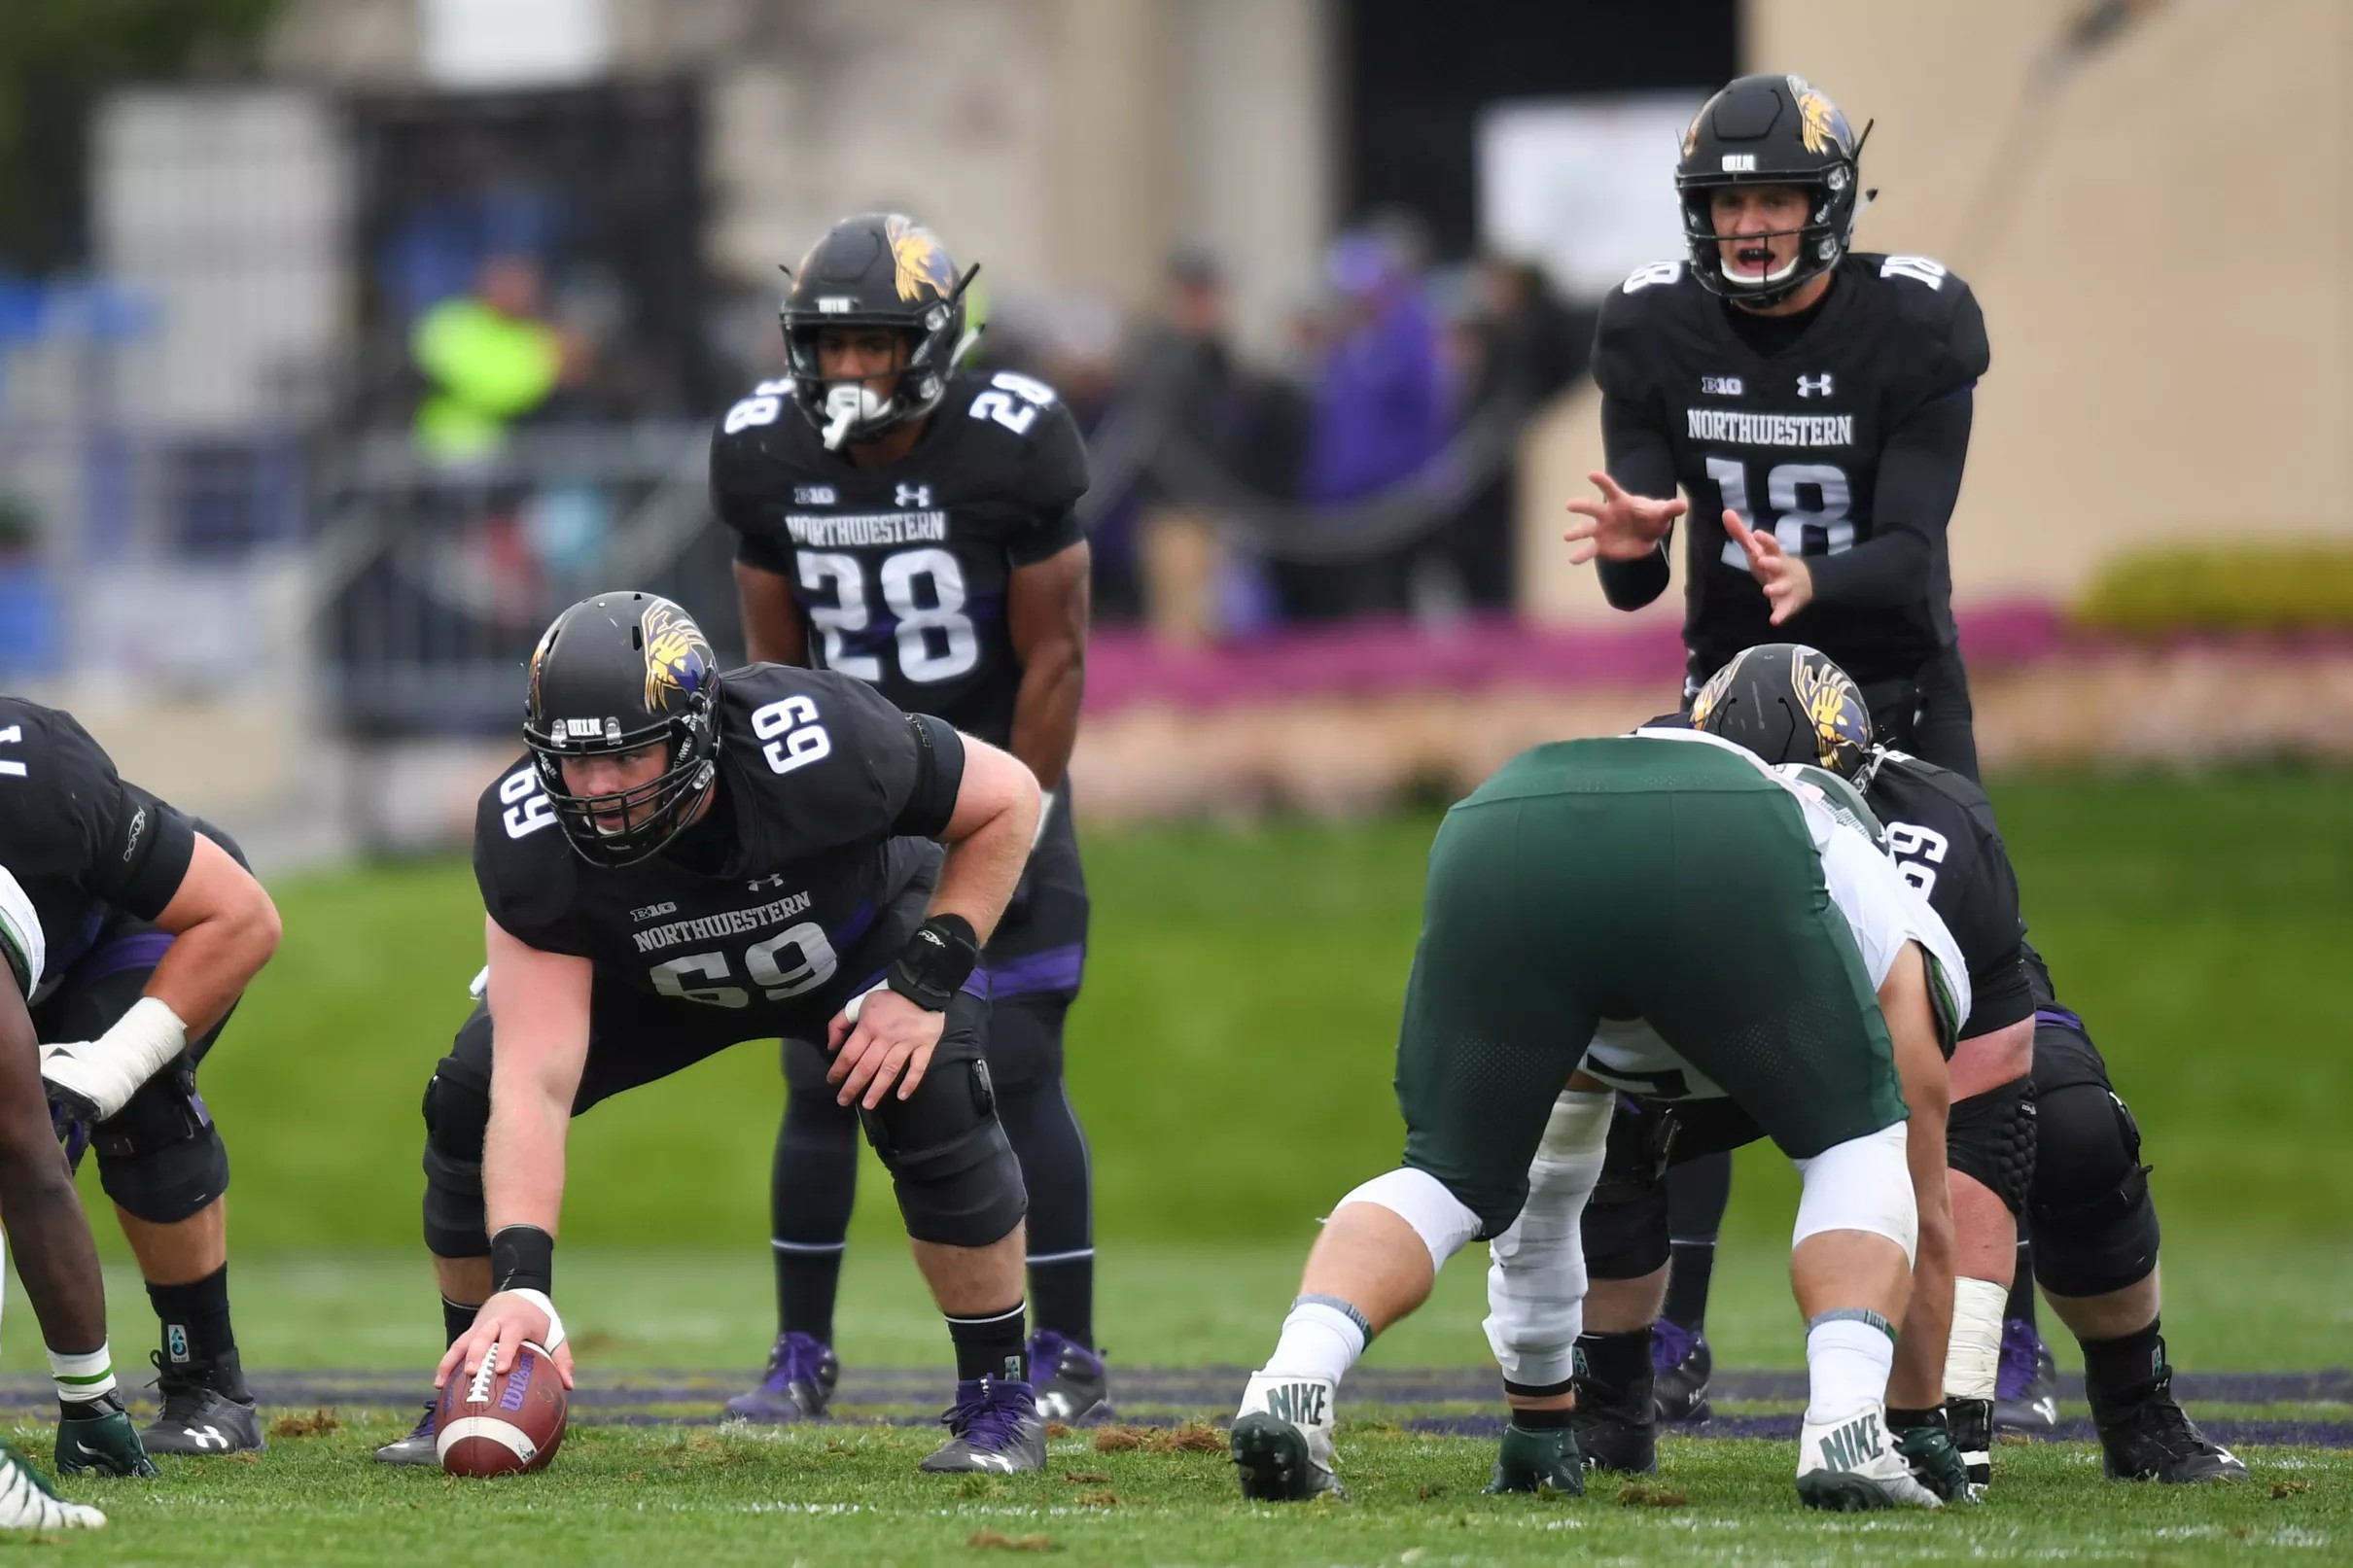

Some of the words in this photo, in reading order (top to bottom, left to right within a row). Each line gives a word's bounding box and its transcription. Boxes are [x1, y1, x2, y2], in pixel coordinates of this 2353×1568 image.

[968, 373, 1054, 435] 28
[1687, 409, 1852, 446] NORTHWESTERN
[785, 510, 945, 547] NORTHWESTERN
[1705, 457, 1854, 572] 18
[796, 548, 978, 682] 28
[751, 694, 831, 775] 69
[632, 890, 811, 953] NORTHWESTERN
[650, 922, 837, 1008] 69
[1266, 1382, 1327, 1426] NIKE
[1818, 1412, 1884, 1474] NIKE
